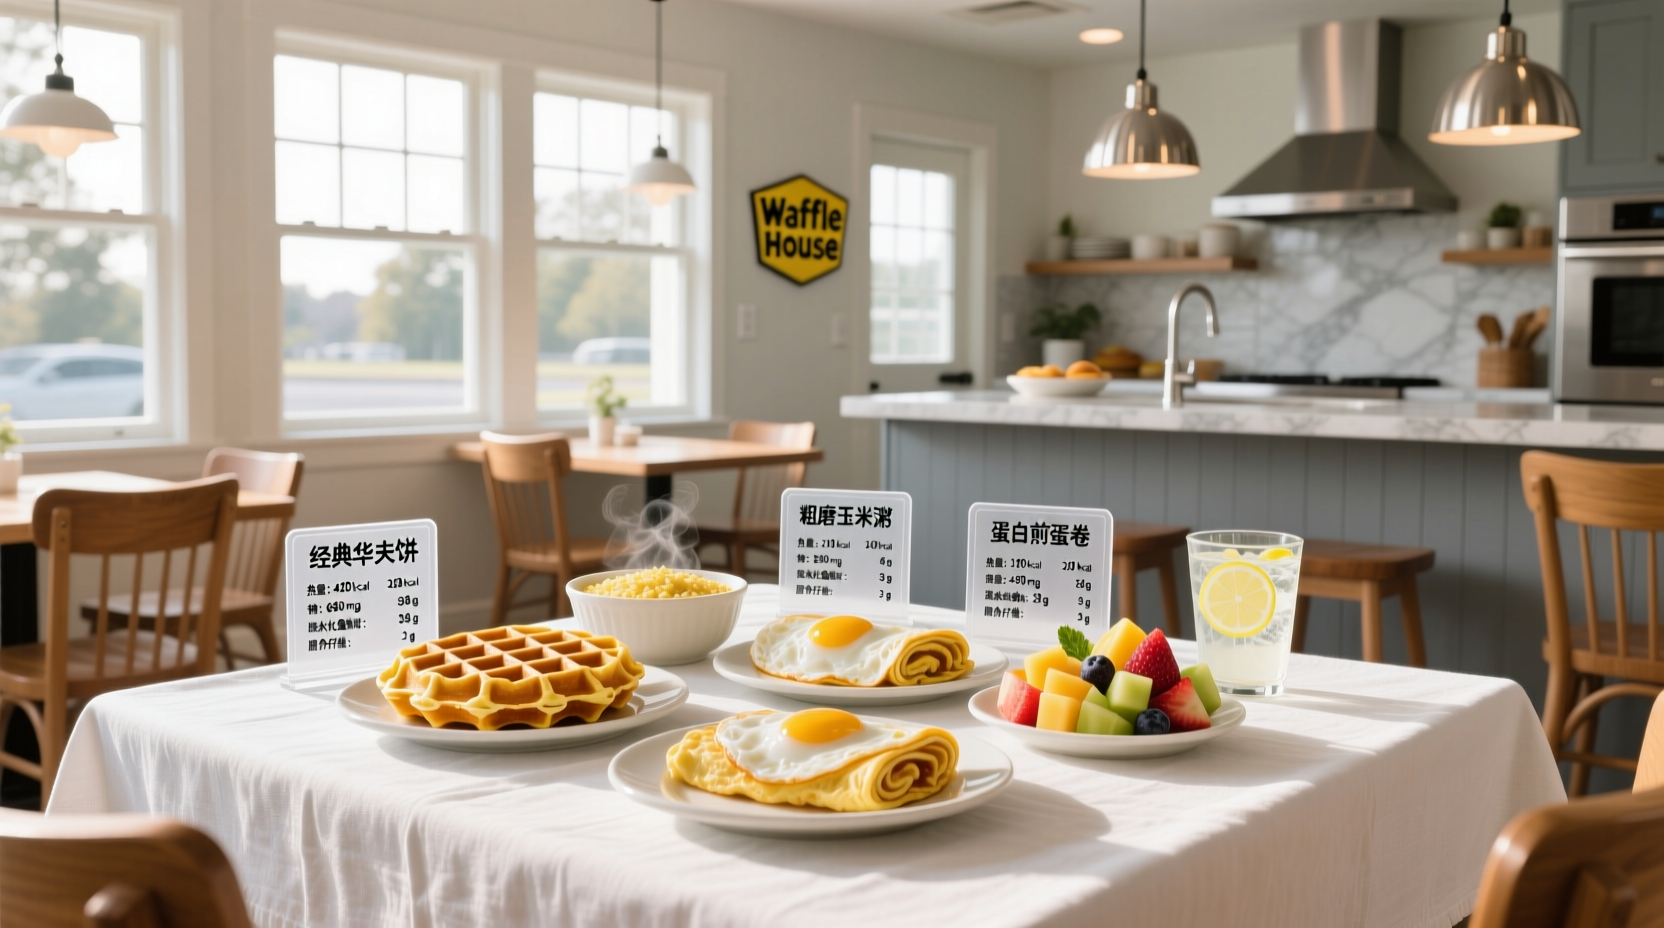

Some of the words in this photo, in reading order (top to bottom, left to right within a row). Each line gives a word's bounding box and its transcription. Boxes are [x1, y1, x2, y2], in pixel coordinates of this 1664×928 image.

[761, 197, 842, 232] Waffle
[765, 231, 838, 261] House
[309, 537, 419, 569] 经典华夫饼
